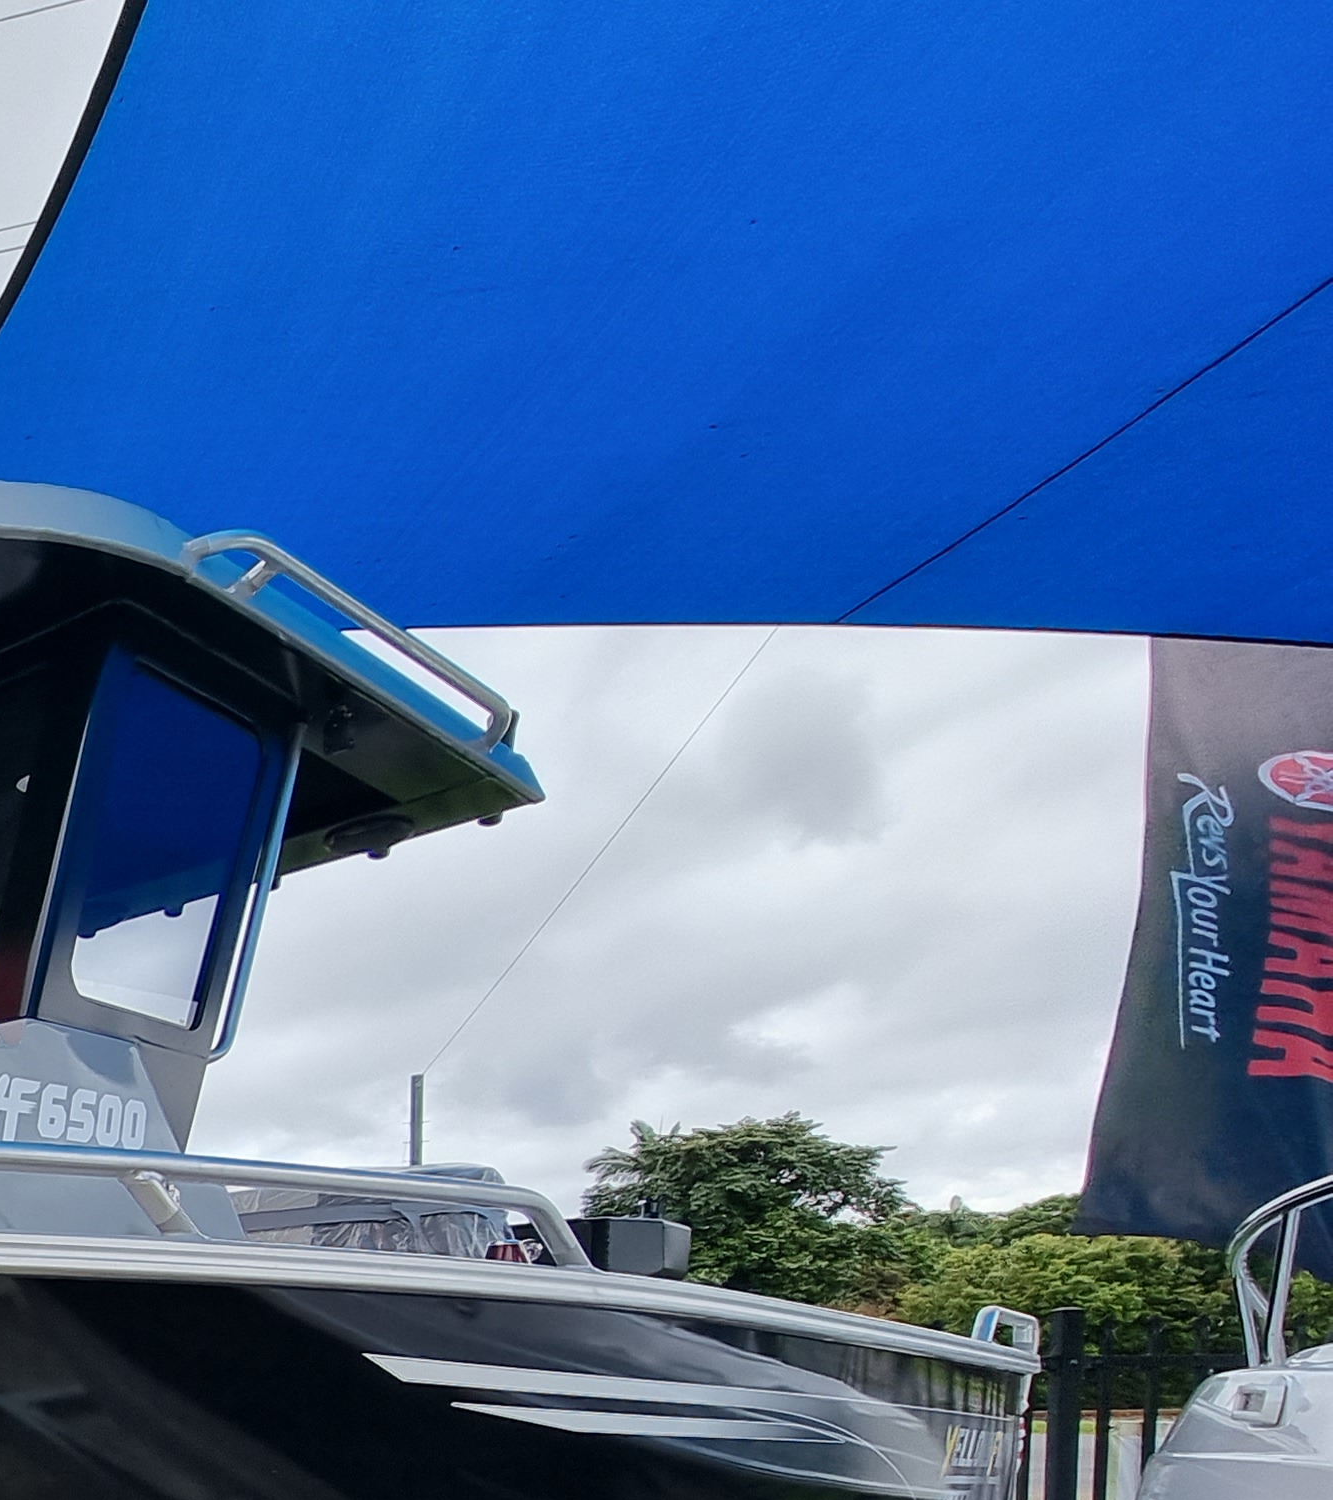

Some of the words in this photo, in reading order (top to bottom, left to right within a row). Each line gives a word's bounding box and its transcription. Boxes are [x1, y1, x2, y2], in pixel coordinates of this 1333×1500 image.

[1177, 772, 1234, 880] Revs
[1185, 867, 1232, 948] Your
[1187, 941, 1231, 1044] Heart
